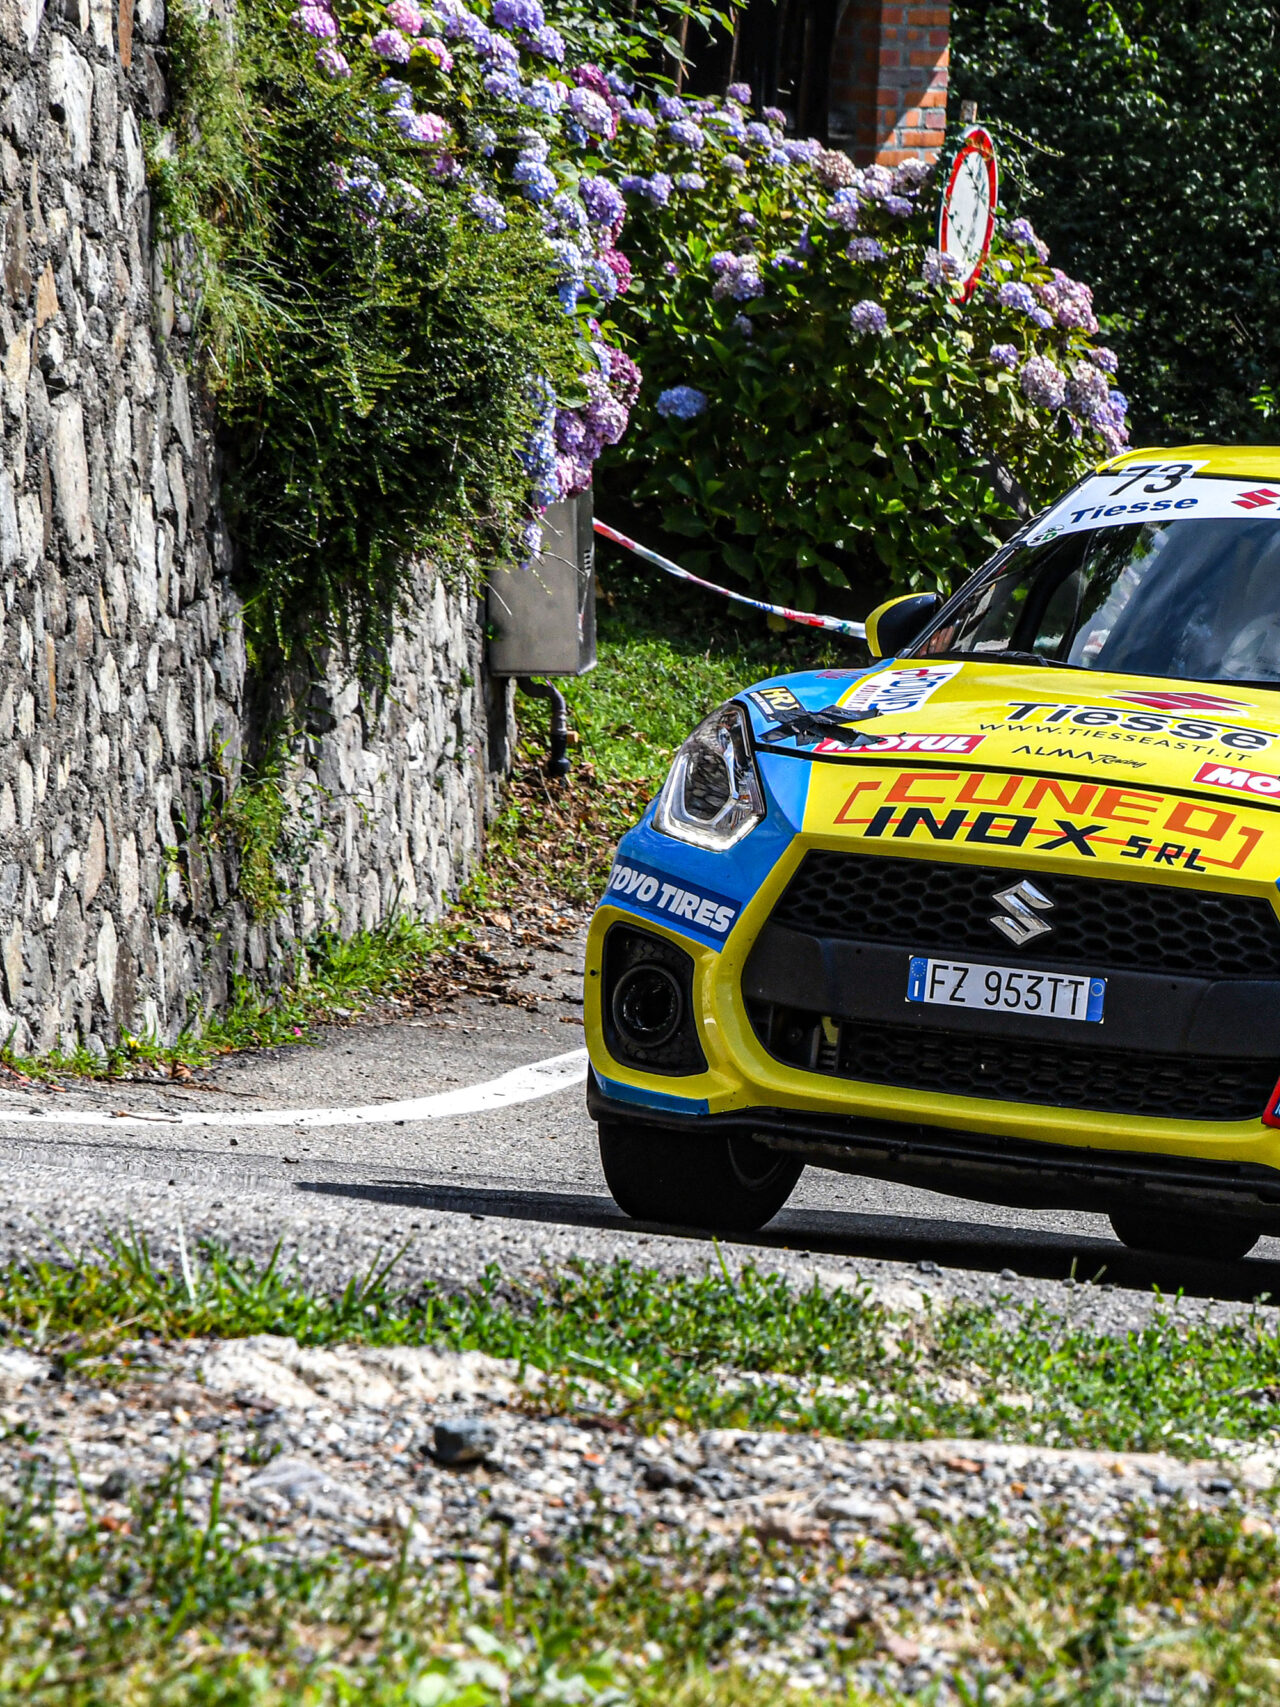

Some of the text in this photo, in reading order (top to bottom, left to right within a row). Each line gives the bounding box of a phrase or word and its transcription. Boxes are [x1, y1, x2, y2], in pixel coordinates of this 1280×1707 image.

[1109, 464, 1193, 497] 73
[1070, 498, 1199, 524] Tiesse
[760, 687, 800, 711] HR
[1006, 702, 1279, 750] Tiesse
[1011, 745, 1096, 761] ALMA
[884, 772, 1238, 841] CUNEO
[863, 805, 1207, 872] INOX SRL
[606, 864, 736, 933] TOYO TIRES
[929, 964, 970, 1003] FZ
[983, 970, 1085, 1016] 953TT
